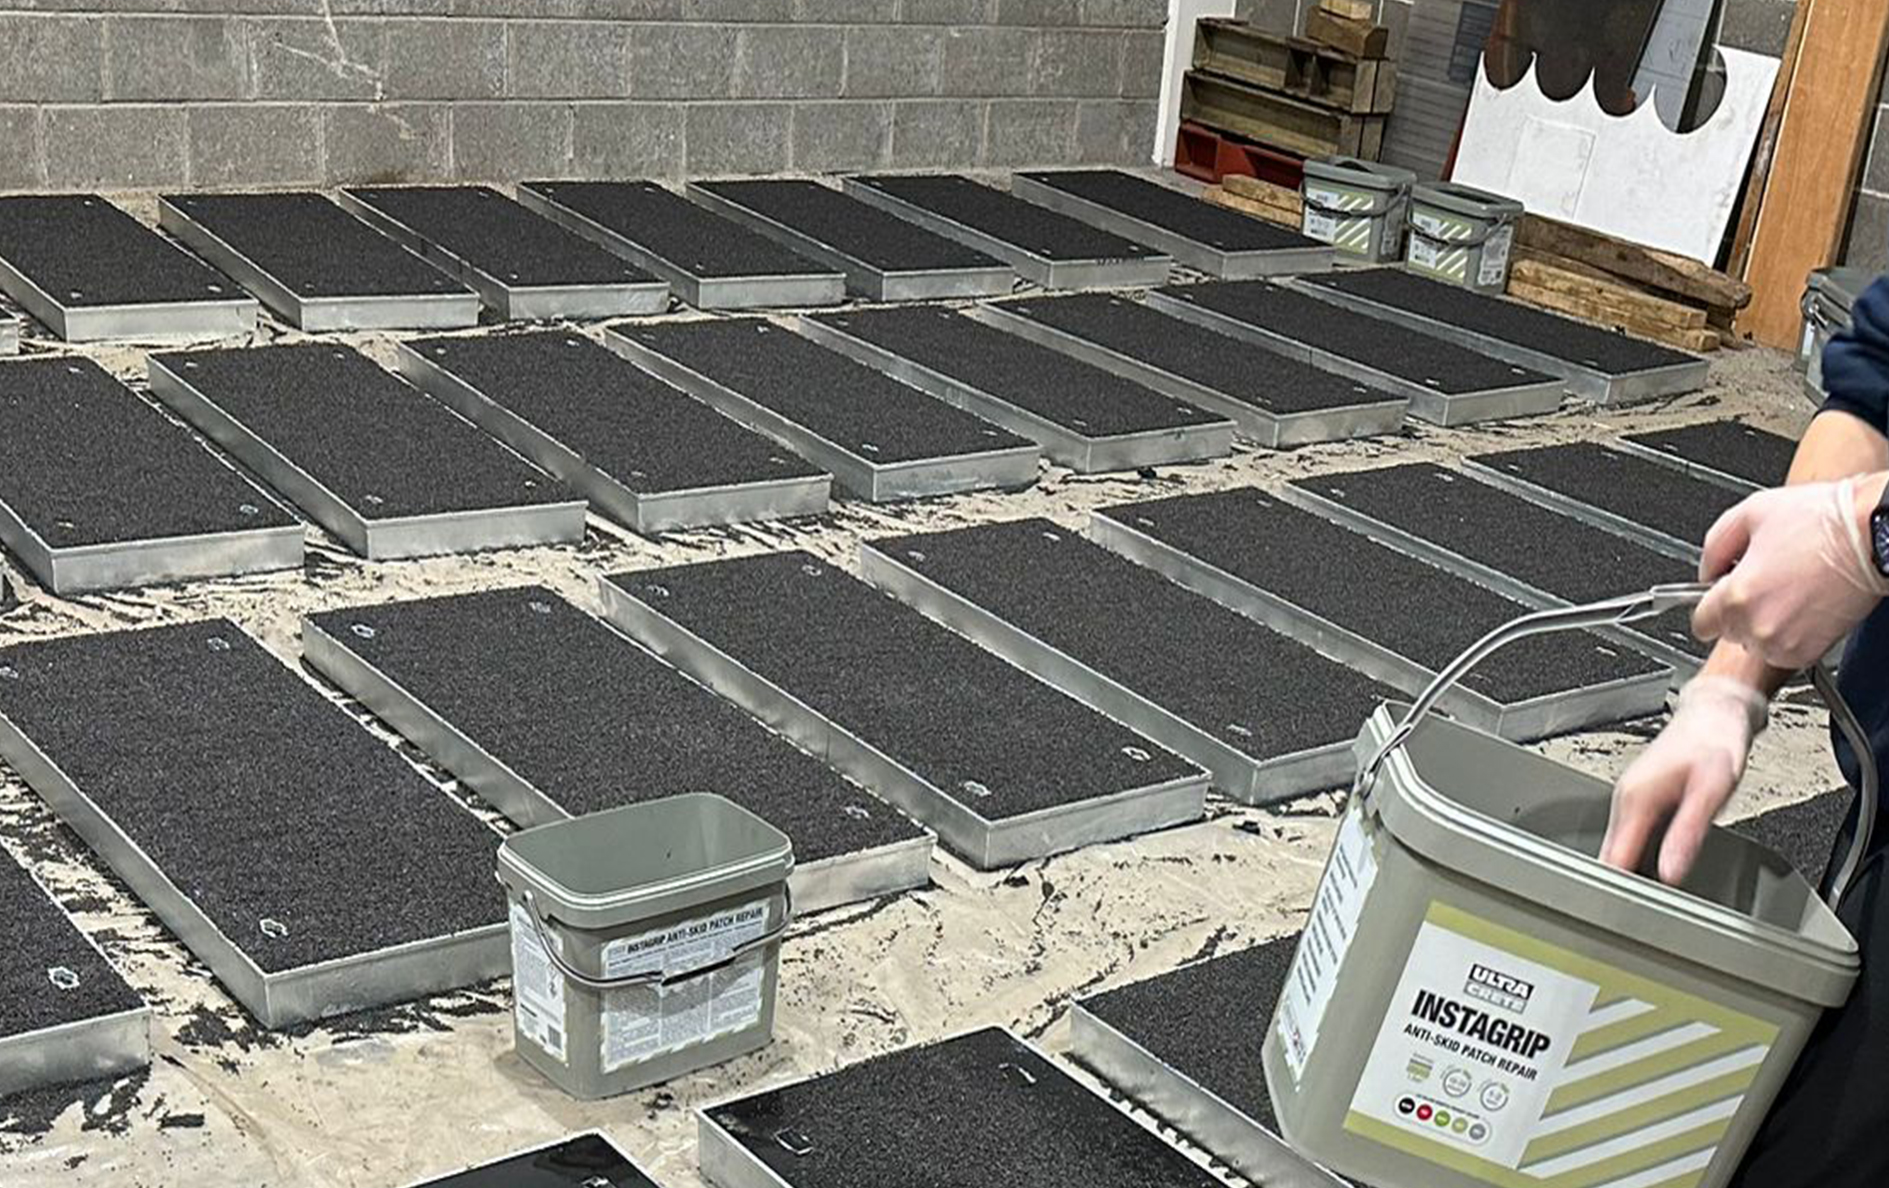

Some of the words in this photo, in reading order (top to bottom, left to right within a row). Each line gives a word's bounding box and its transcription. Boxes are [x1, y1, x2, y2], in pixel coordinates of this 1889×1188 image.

[668, 924, 707, 942] ANTI-SKID
[709, 915, 734, 932] PATCH
[735, 907, 763, 924] REPAIR
[1471, 965, 1531, 999] ULTRA
[1411, 989, 1551, 1059] INSTAGRIP
[1403, 1023, 1460, 1053] ANTI-SKID
[1461, 1044, 1497, 1066] PATCH
[1498, 1056, 1538, 1081] REPAIR
